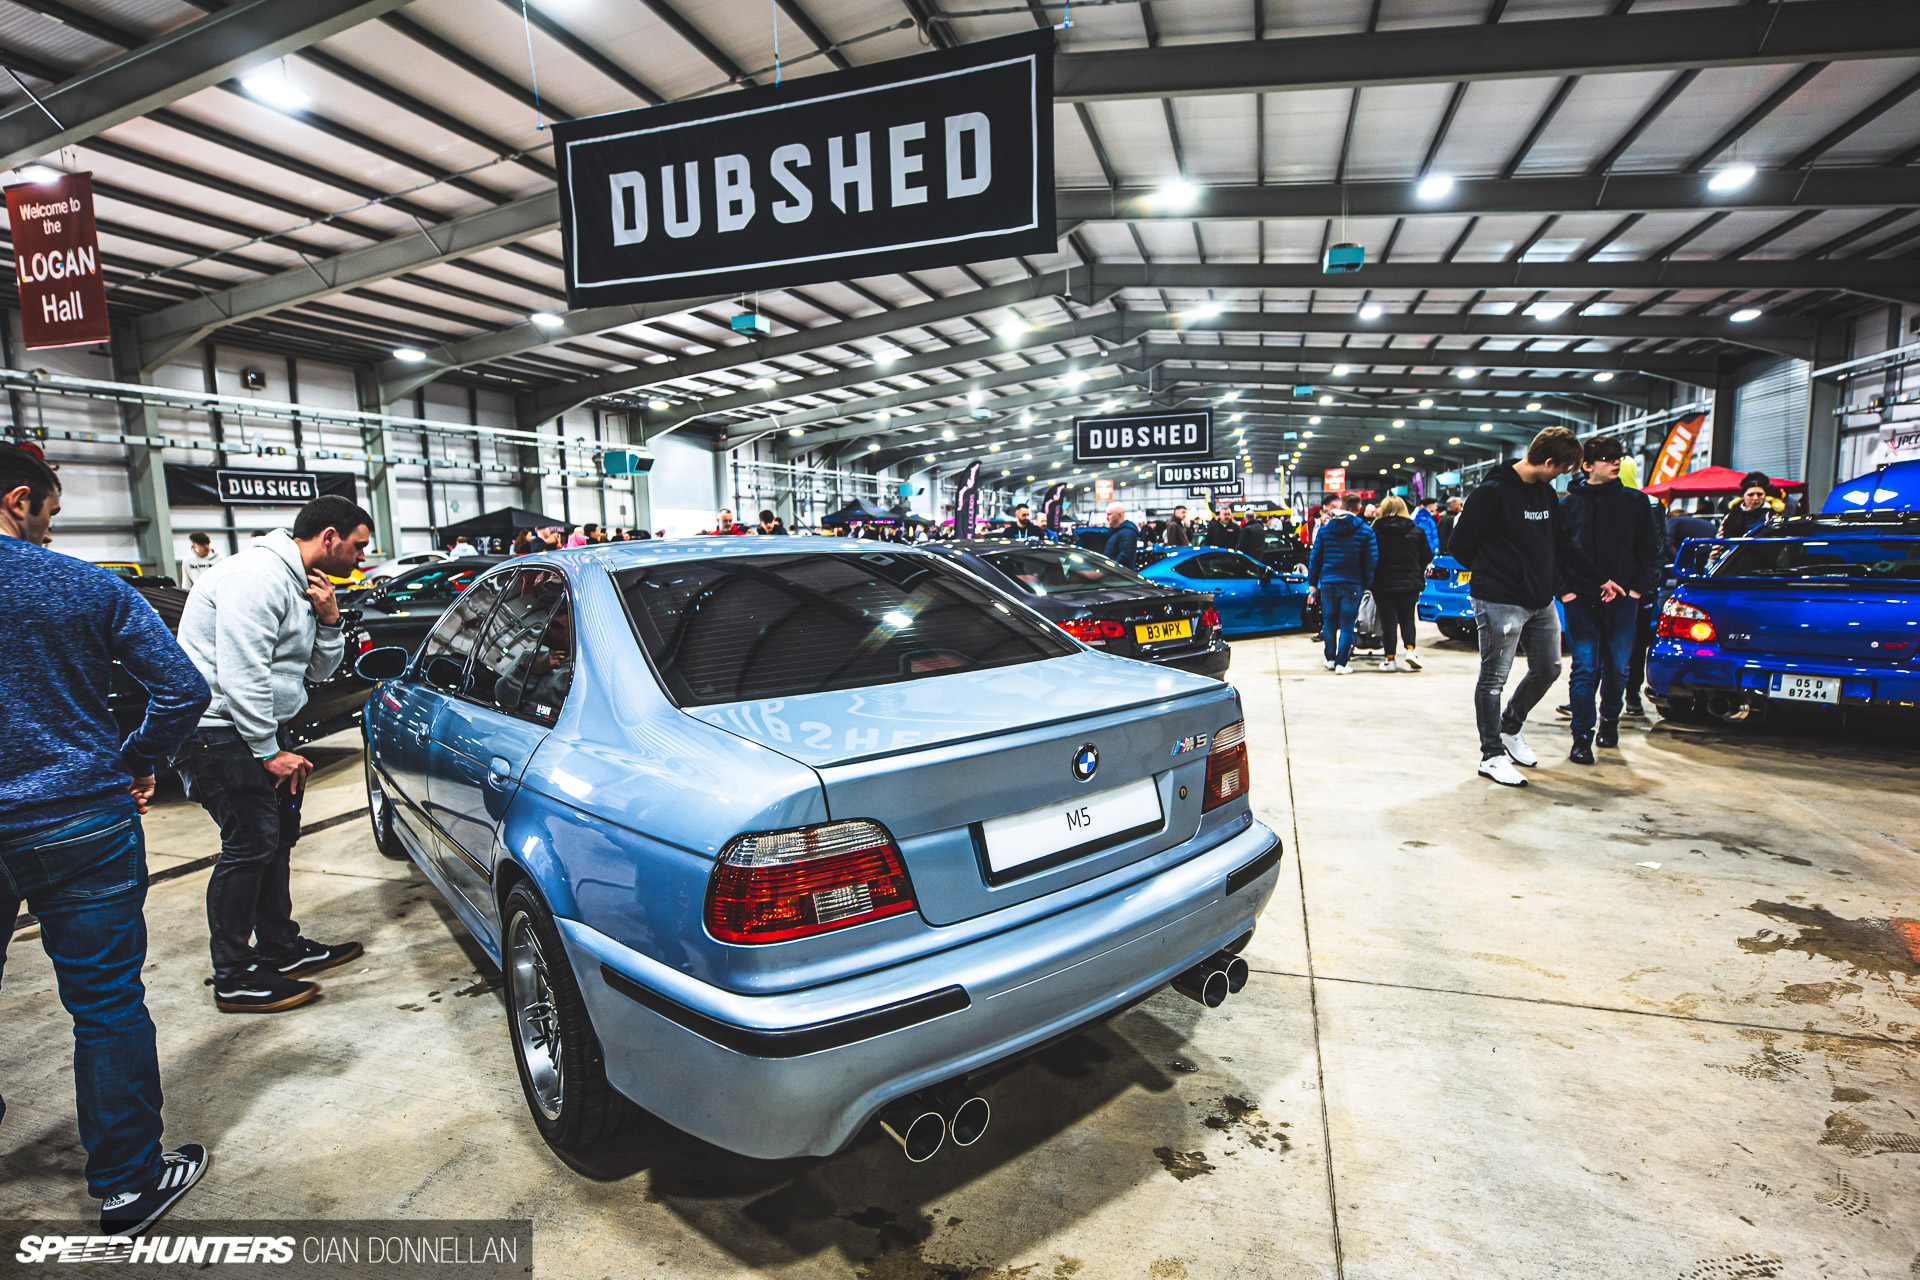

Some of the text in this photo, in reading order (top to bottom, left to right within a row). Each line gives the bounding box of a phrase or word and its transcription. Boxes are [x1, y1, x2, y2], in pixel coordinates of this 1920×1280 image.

[609, 111, 992, 247] DUBSHED
[19, 197, 81, 221] Welcome to
[43, 219, 62, 235] the
[19, 245, 96, 283] LOGAN
[41, 290, 83, 323] Hall
[1089, 423, 1198, 450] DUBSHED
[1164, 465, 1229, 482] DUBSHED
[227, 478, 312, 497] DUBSHED
[1146, 622, 1182, 640] B3 MPX
[1789, 688, 1827, 699] 87244
[1796, 678, 1823, 689] 05 D
[1174, 732, 1207, 755] M5
[1066, 807, 1091, 831] M5
